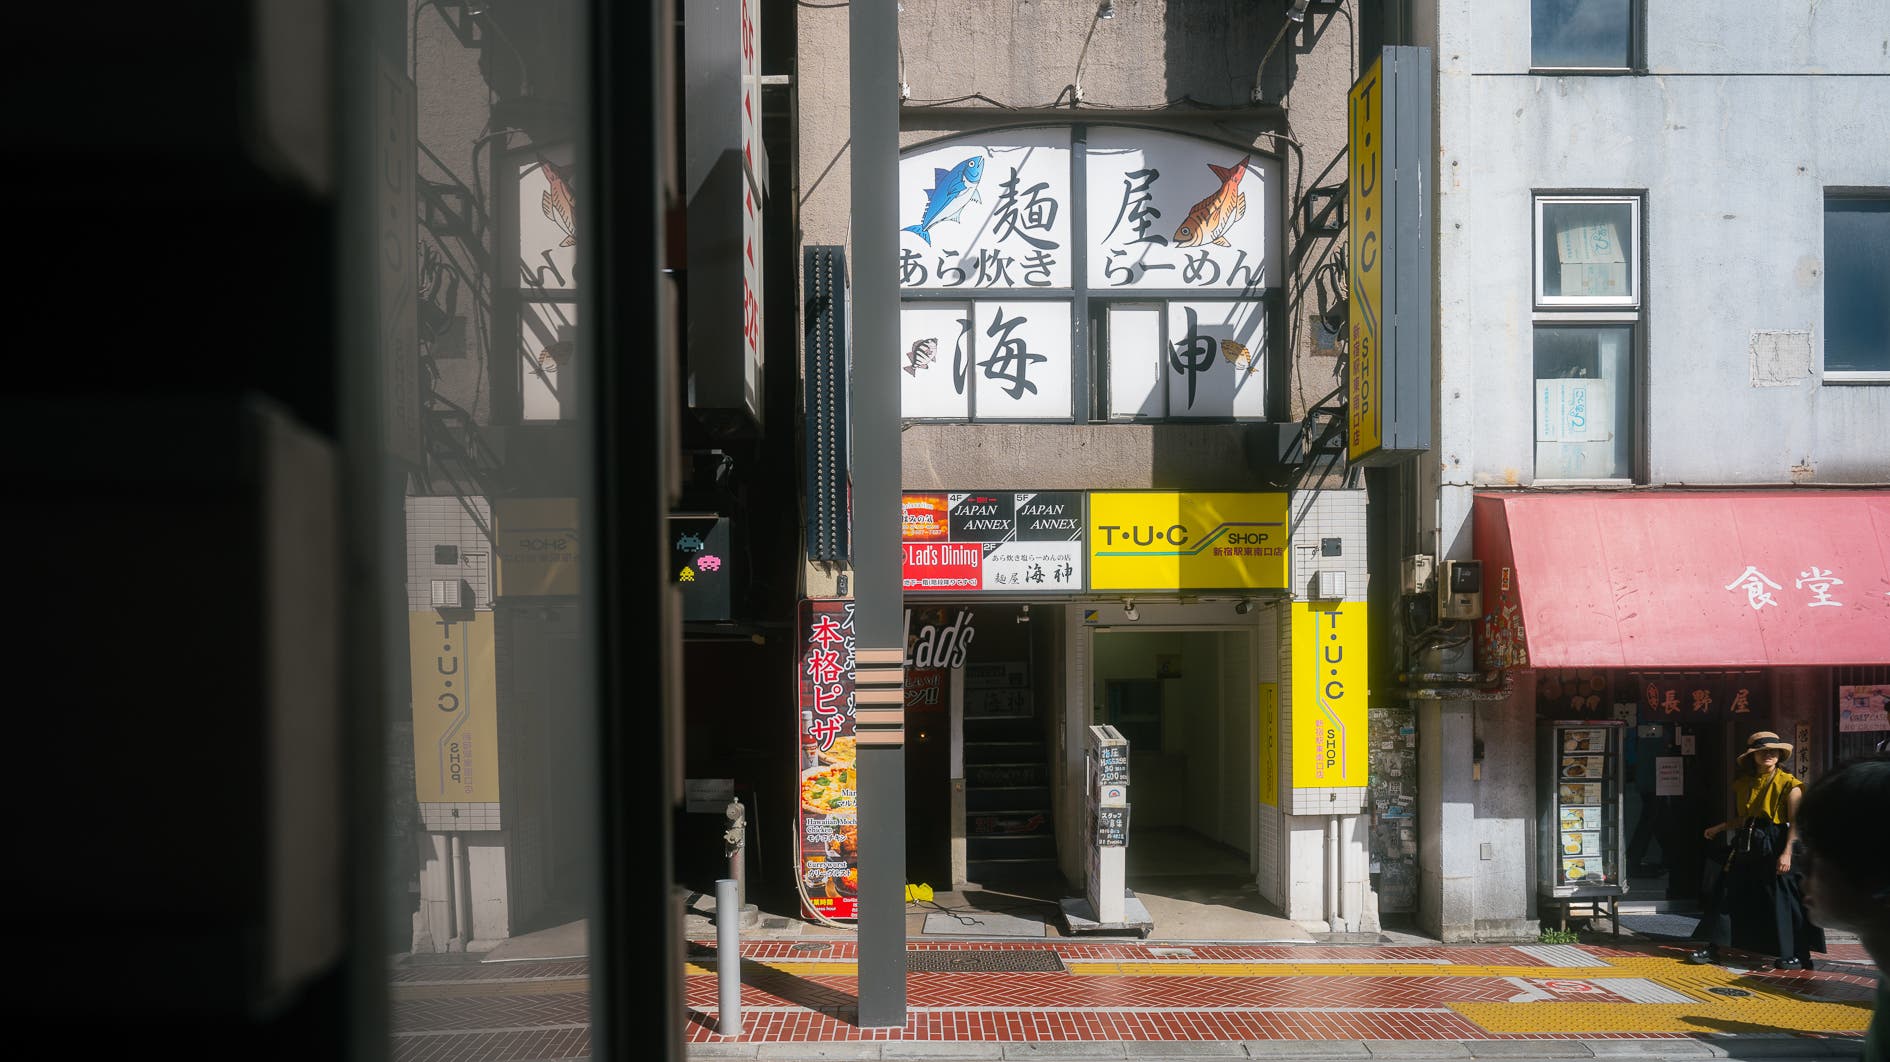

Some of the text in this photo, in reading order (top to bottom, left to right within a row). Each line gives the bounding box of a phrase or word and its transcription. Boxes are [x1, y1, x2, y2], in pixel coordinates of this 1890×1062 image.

[900, 248, 1057, 287] あら炊き
[1105, 249, 1265, 287] らーめん
[949, 494, 962, 502] 4F
[1016, 494, 1029, 502] 5F
[955, 505, 998, 516] JAPAN
[1021, 504, 1064, 515] JAPAN
[963, 520, 1011, 530] ANNEX
[1030, 519, 1078, 530] ANNEX
[1228, 532, 1269, 545] SHOP
[909, 545, 978, 567] Lad's Dining
[1213, 547, 1284, 557] 新宿駅東南口店
[1725, 566, 1845, 610] 食堂
[809, 615, 845, 751] 本格ピザ
[1661, 687, 1751, 715] 長野屋
[1326, 729, 1336, 769] SHOP
